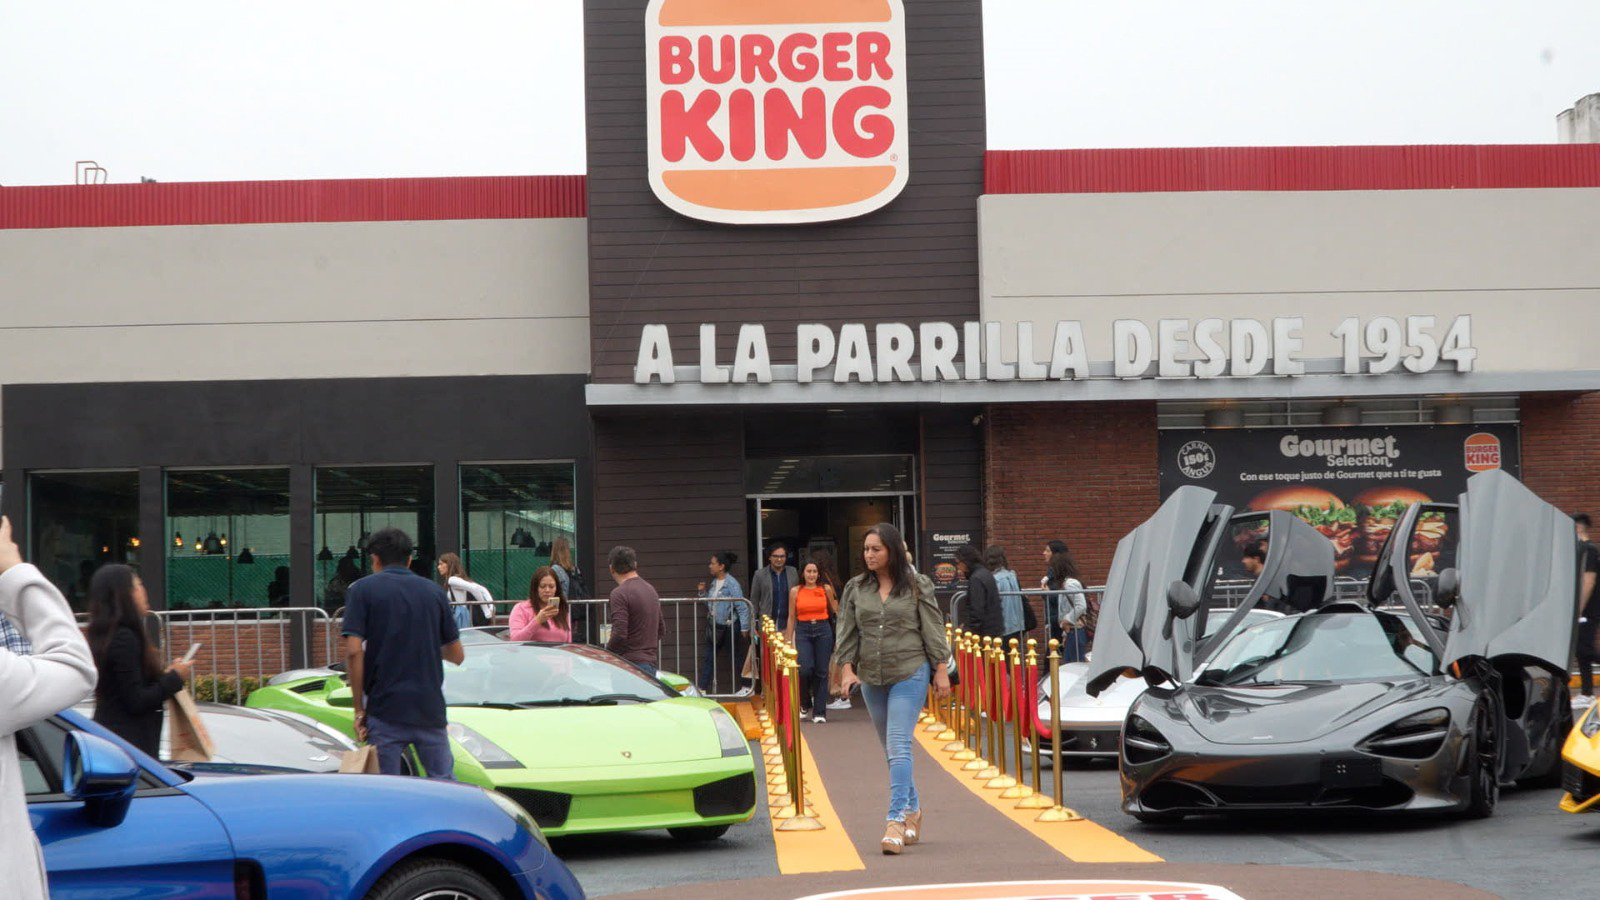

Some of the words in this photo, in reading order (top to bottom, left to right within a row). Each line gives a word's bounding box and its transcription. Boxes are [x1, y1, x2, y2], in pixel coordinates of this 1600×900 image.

[658, 31, 894, 85] BURGER
[660, 85, 895, 162] KING
[634, 323, 676, 384] A
[700, 322, 773, 384] LA
[797, 318, 1089, 383] PARRILLA
[1113, 317, 1305, 378] DESDE
[1330, 314, 1478, 374] 1954
[1280, 434, 1400, 458] Gourmet
[1466, 445, 1499, 453] BURGER
[1326, 453, 1394, 468] Selection
[1466, 453, 1500, 464] KING
[1182, 461, 1214, 477] ANGUS
[1240, 472, 1257, 481] Con
[1275, 473, 1300, 482] toque
[1300, 471, 1322, 482] justo
[1323, 471, 1336, 480] de
[1336, 470, 1375, 480] Gourmet
[1375, 471, 1393, 480] que
[1408, 470, 1416, 478] te
[1418, 469, 1442, 479] gusta
[933, 533, 970, 541] Gourmet
